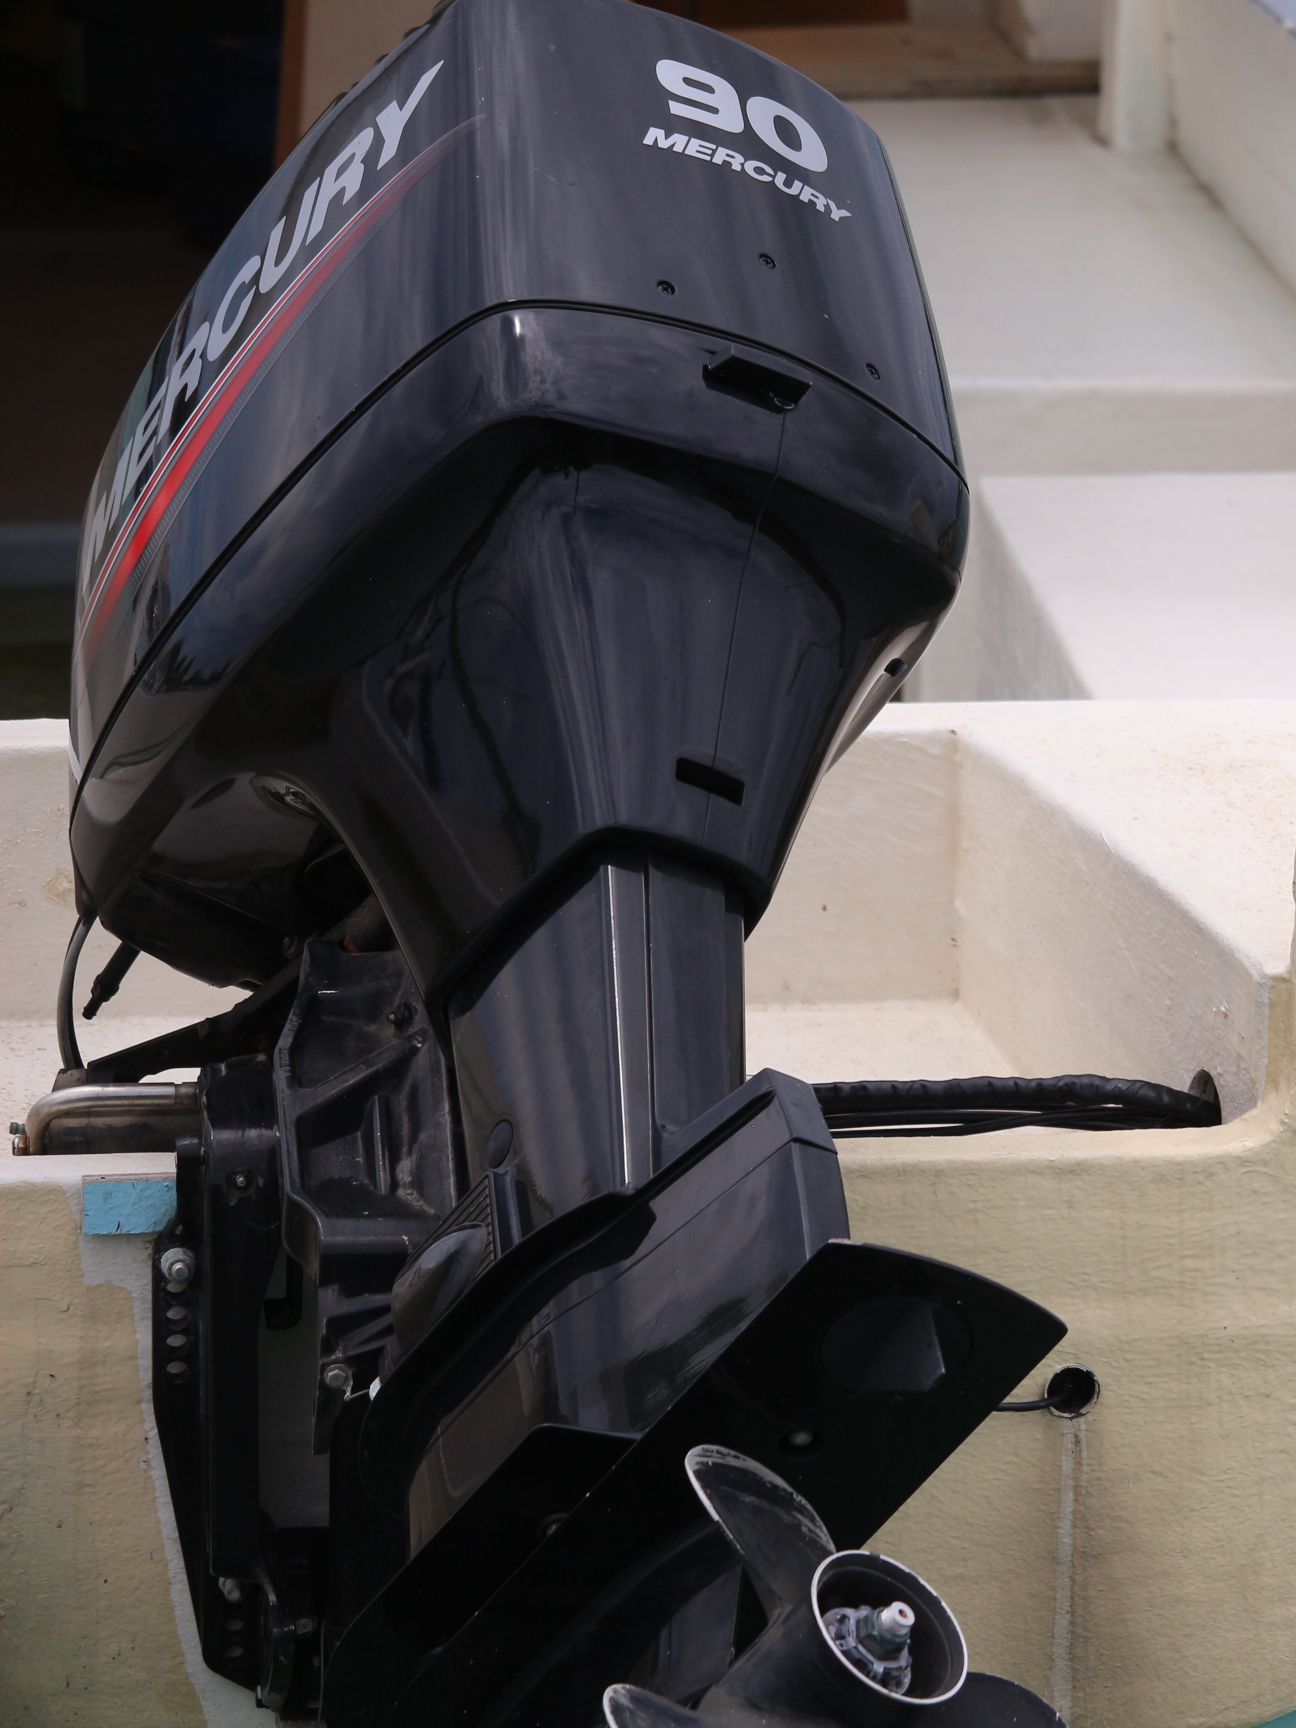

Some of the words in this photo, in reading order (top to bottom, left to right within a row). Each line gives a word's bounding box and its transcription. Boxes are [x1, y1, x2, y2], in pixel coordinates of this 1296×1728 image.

[655, 59, 828, 173] 90
[642, 126, 852, 222] MERCURY
[82, 60, 444, 596] MERCURY
